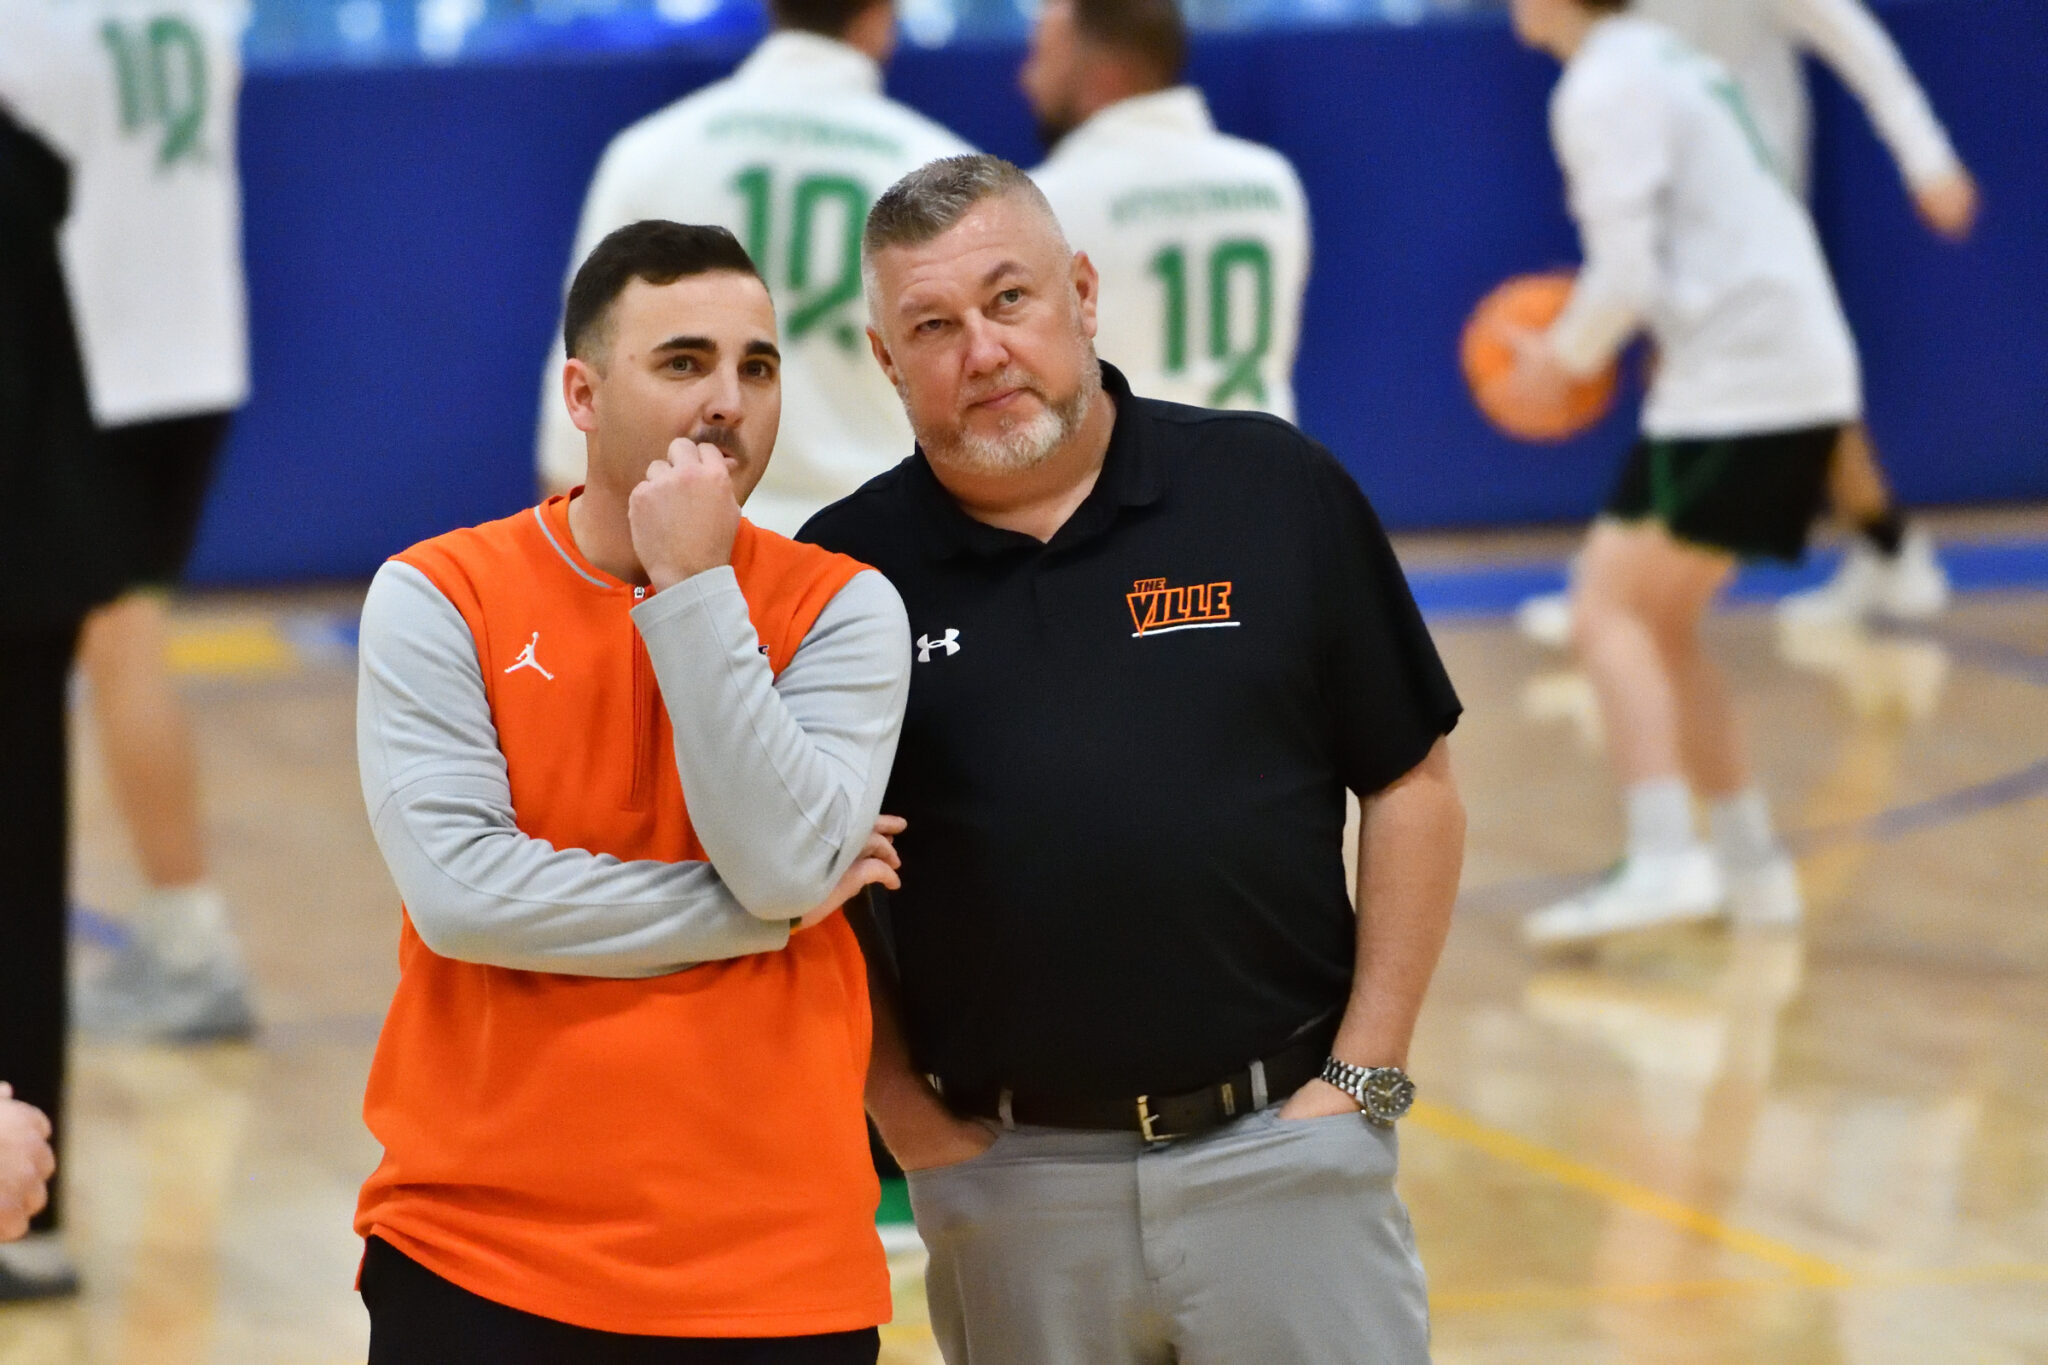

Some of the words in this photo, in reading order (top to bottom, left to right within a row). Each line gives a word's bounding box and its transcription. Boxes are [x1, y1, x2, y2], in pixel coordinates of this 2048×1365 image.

[733, 166, 867, 345] 10
[1149, 239, 1272, 406] 10
[1126, 581, 1232, 638] VILLE
[1133, 577, 1167, 593] THE
